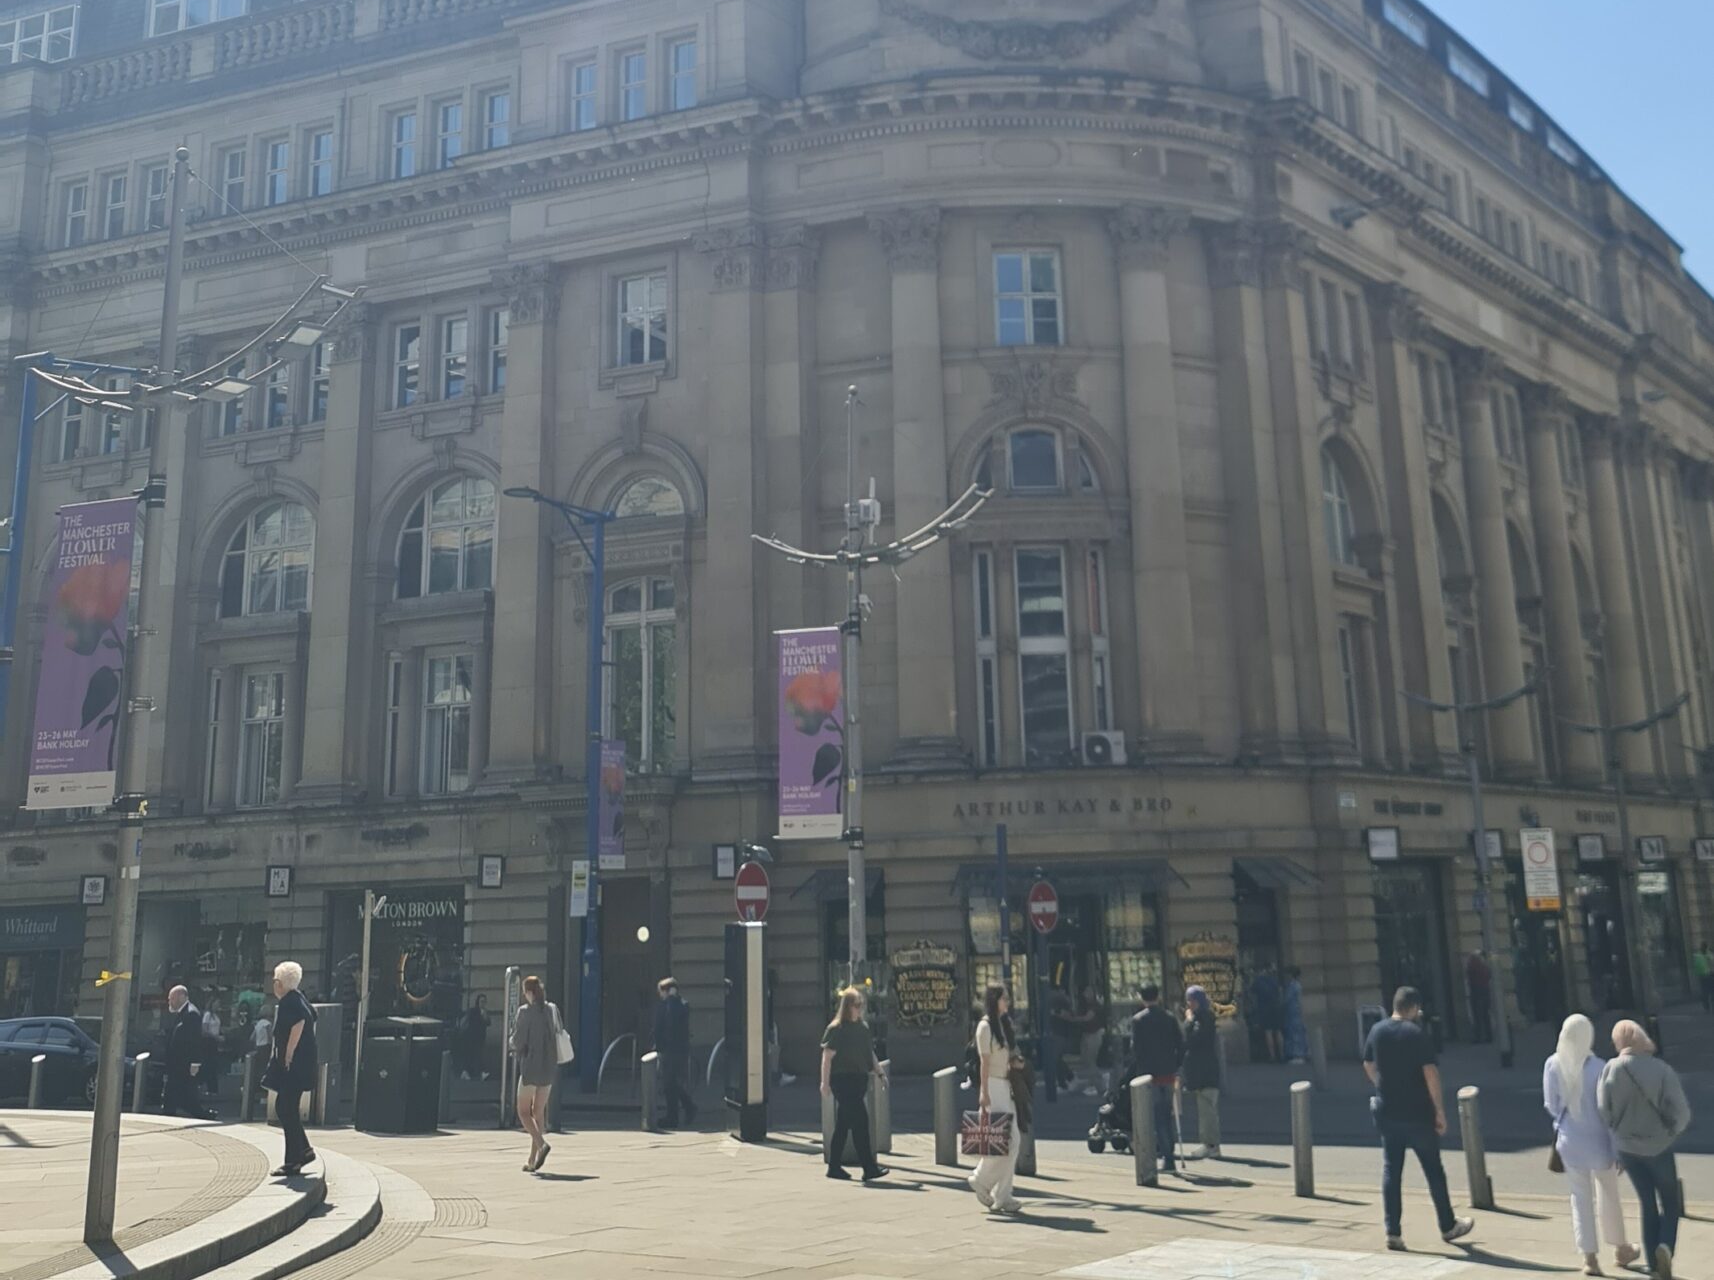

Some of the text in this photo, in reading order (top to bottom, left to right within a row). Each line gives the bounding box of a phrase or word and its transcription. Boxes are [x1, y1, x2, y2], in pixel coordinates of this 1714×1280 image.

[63, 514, 83, 528] THE
[62, 522, 130, 541] MANCHESTER
[60, 537, 116, 555] FLOWER
[58, 552, 105, 569] FESTIVAL
[783, 637, 799, 647] THE
[783, 644, 837, 656] MANCHESTER
[783, 665, 820, 676] FESTIVAL
[62, 730, 78, 739] MAY
[37, 739, 90, 751] BANK HOLIDAY
[953, 800, 1047, 817] ARTHUR
[1058, 798, 1098, 814] KAY
[1110, 798, 1121, 812] &
[408, 900, 457, 919] BROWN
[6, 915, 58, 934] Whittard
